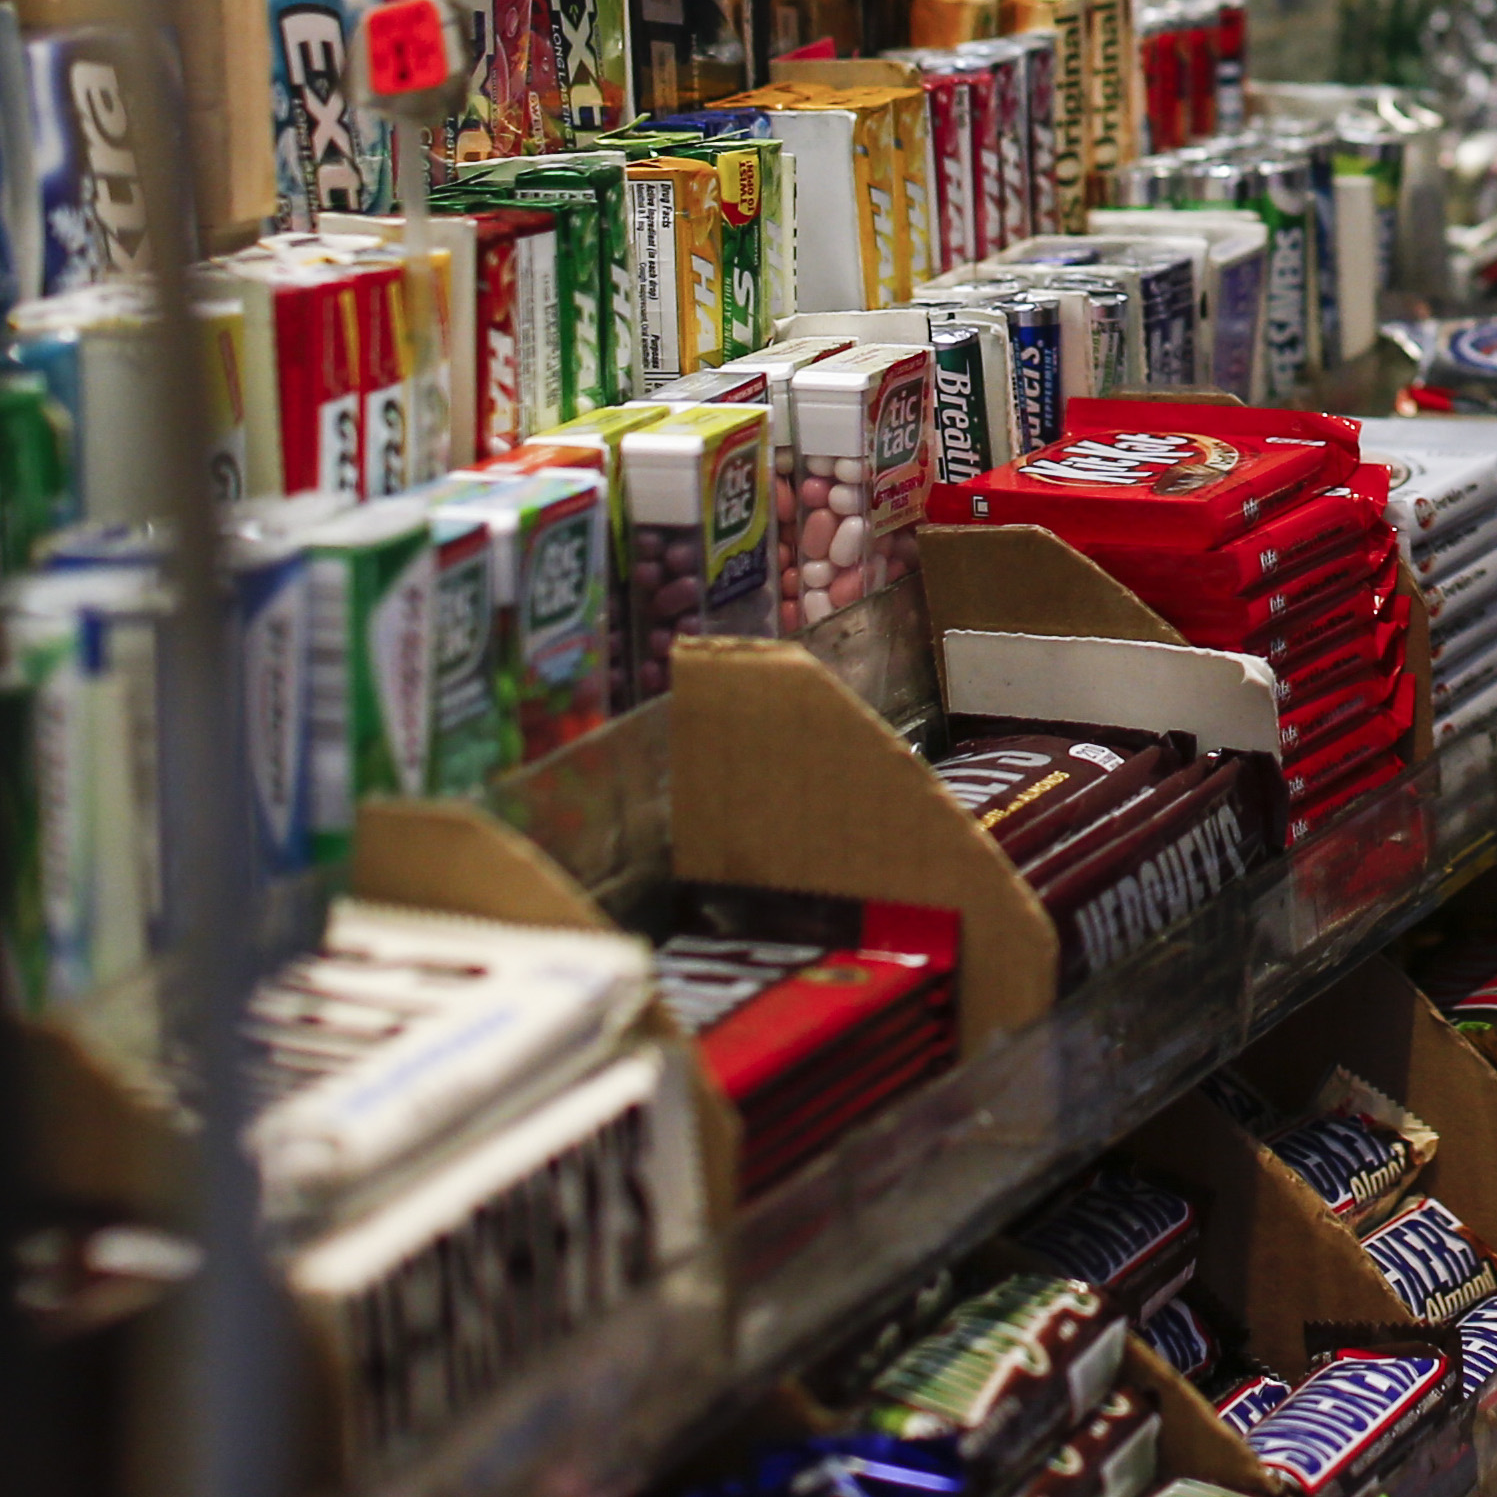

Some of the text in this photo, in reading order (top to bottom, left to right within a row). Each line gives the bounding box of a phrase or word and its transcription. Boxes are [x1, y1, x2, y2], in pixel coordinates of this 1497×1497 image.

[551, 23, 564, 69] LONG
[1054, 15, 1080, 187] Original
[1092, 2, 1118, 172] Original
[646, 184, 658, 207] Active
[738, 161, 748, 207] TWIST
[660, 183, 673, 228] Drug Facts
[647, 209, 658, 246] Ingredient
[648, 261, 658, 278] each
[648, 280, 659, 301] drop)
[650, 334, 660, 369] Purposes
[889, 390, 917, 428] tic
[1042, 348, 1054, 428] PEPPERMINT
[882, 420, 918, 459] tac
[1017, 432, 1196, 485] KitKat
[724, 459, 754, 494] tic
[1424, 1260, 1497, 1326] Almond
